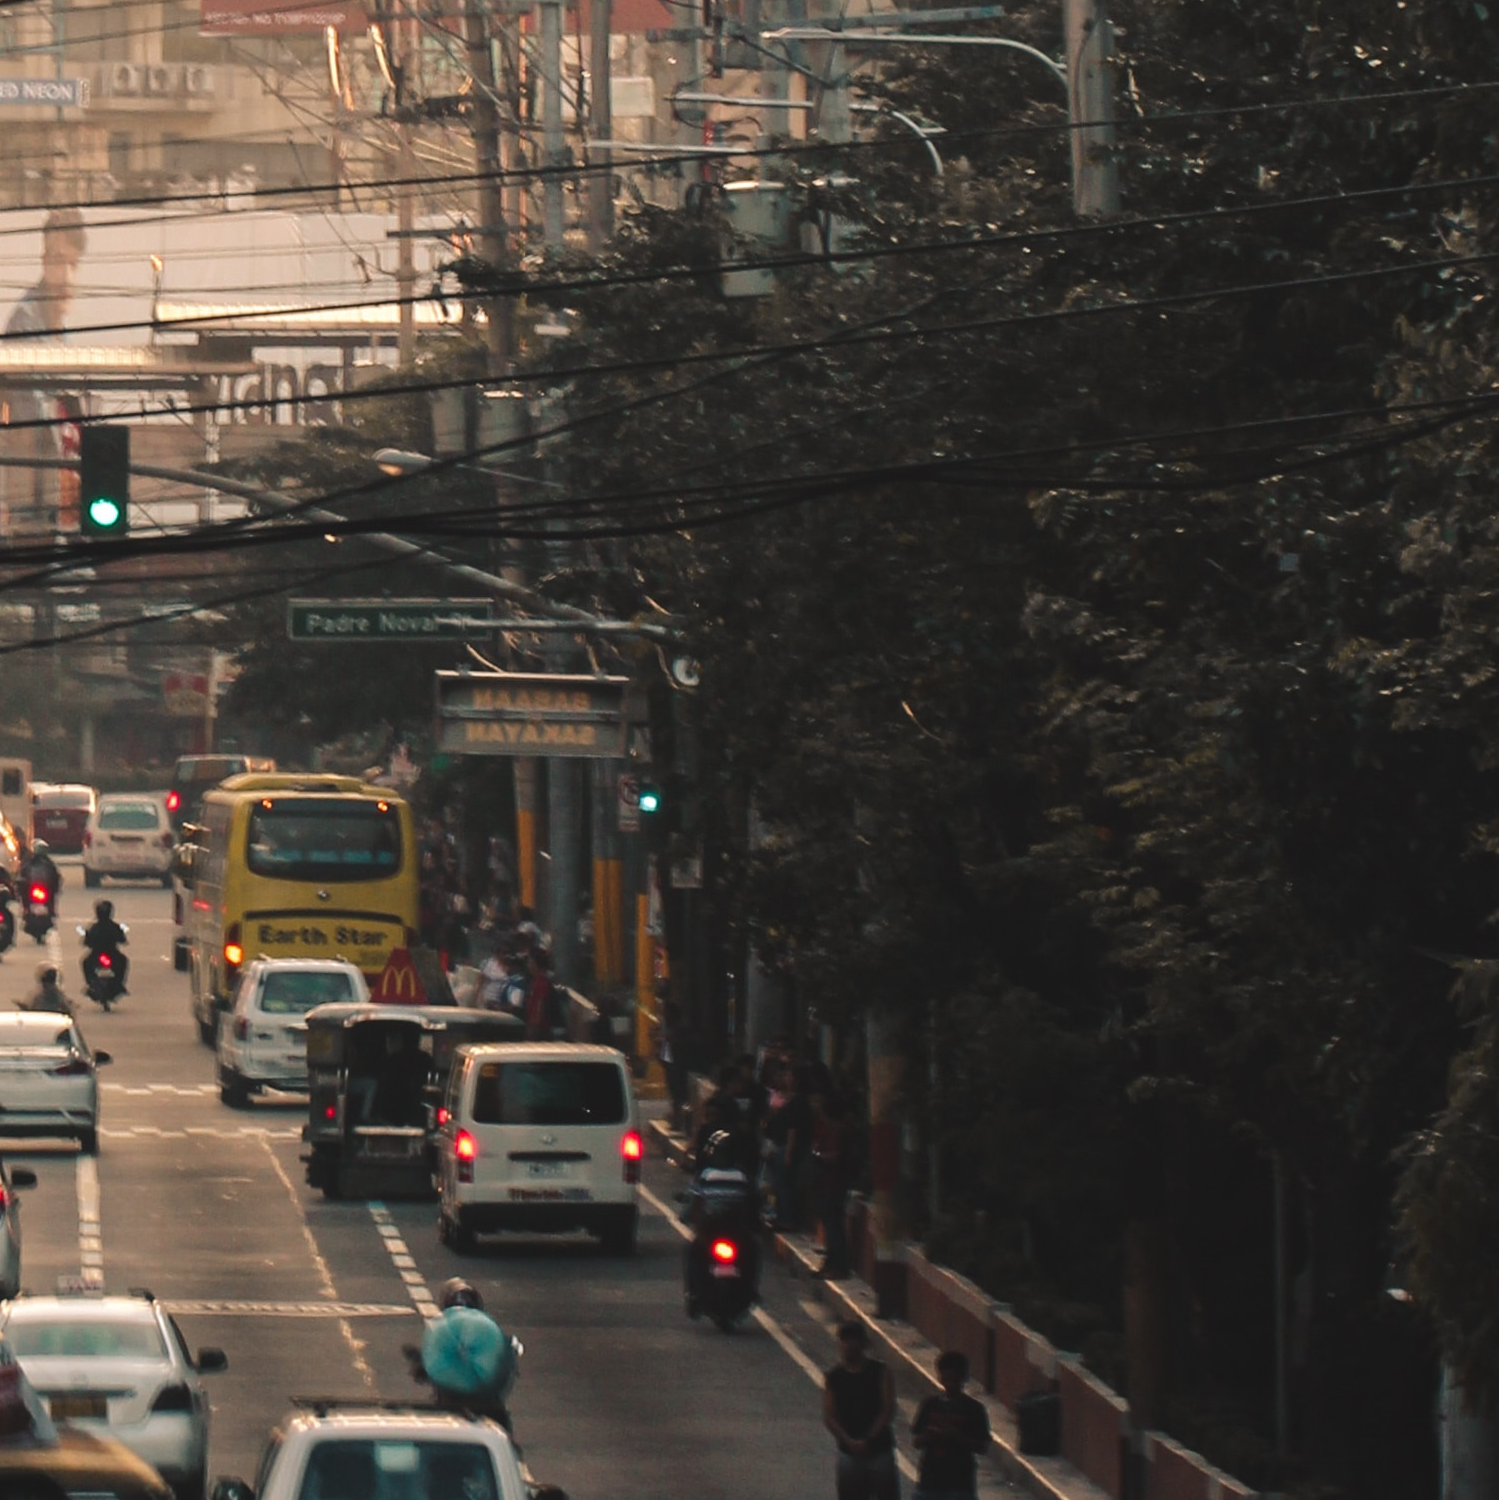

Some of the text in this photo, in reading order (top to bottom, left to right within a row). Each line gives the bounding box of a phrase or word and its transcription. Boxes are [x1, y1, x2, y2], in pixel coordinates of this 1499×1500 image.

[22, 82, 74, 99] NEON
[307, 611, 370, 633] Padre
[259, 924, 388, 946] Earth Star
